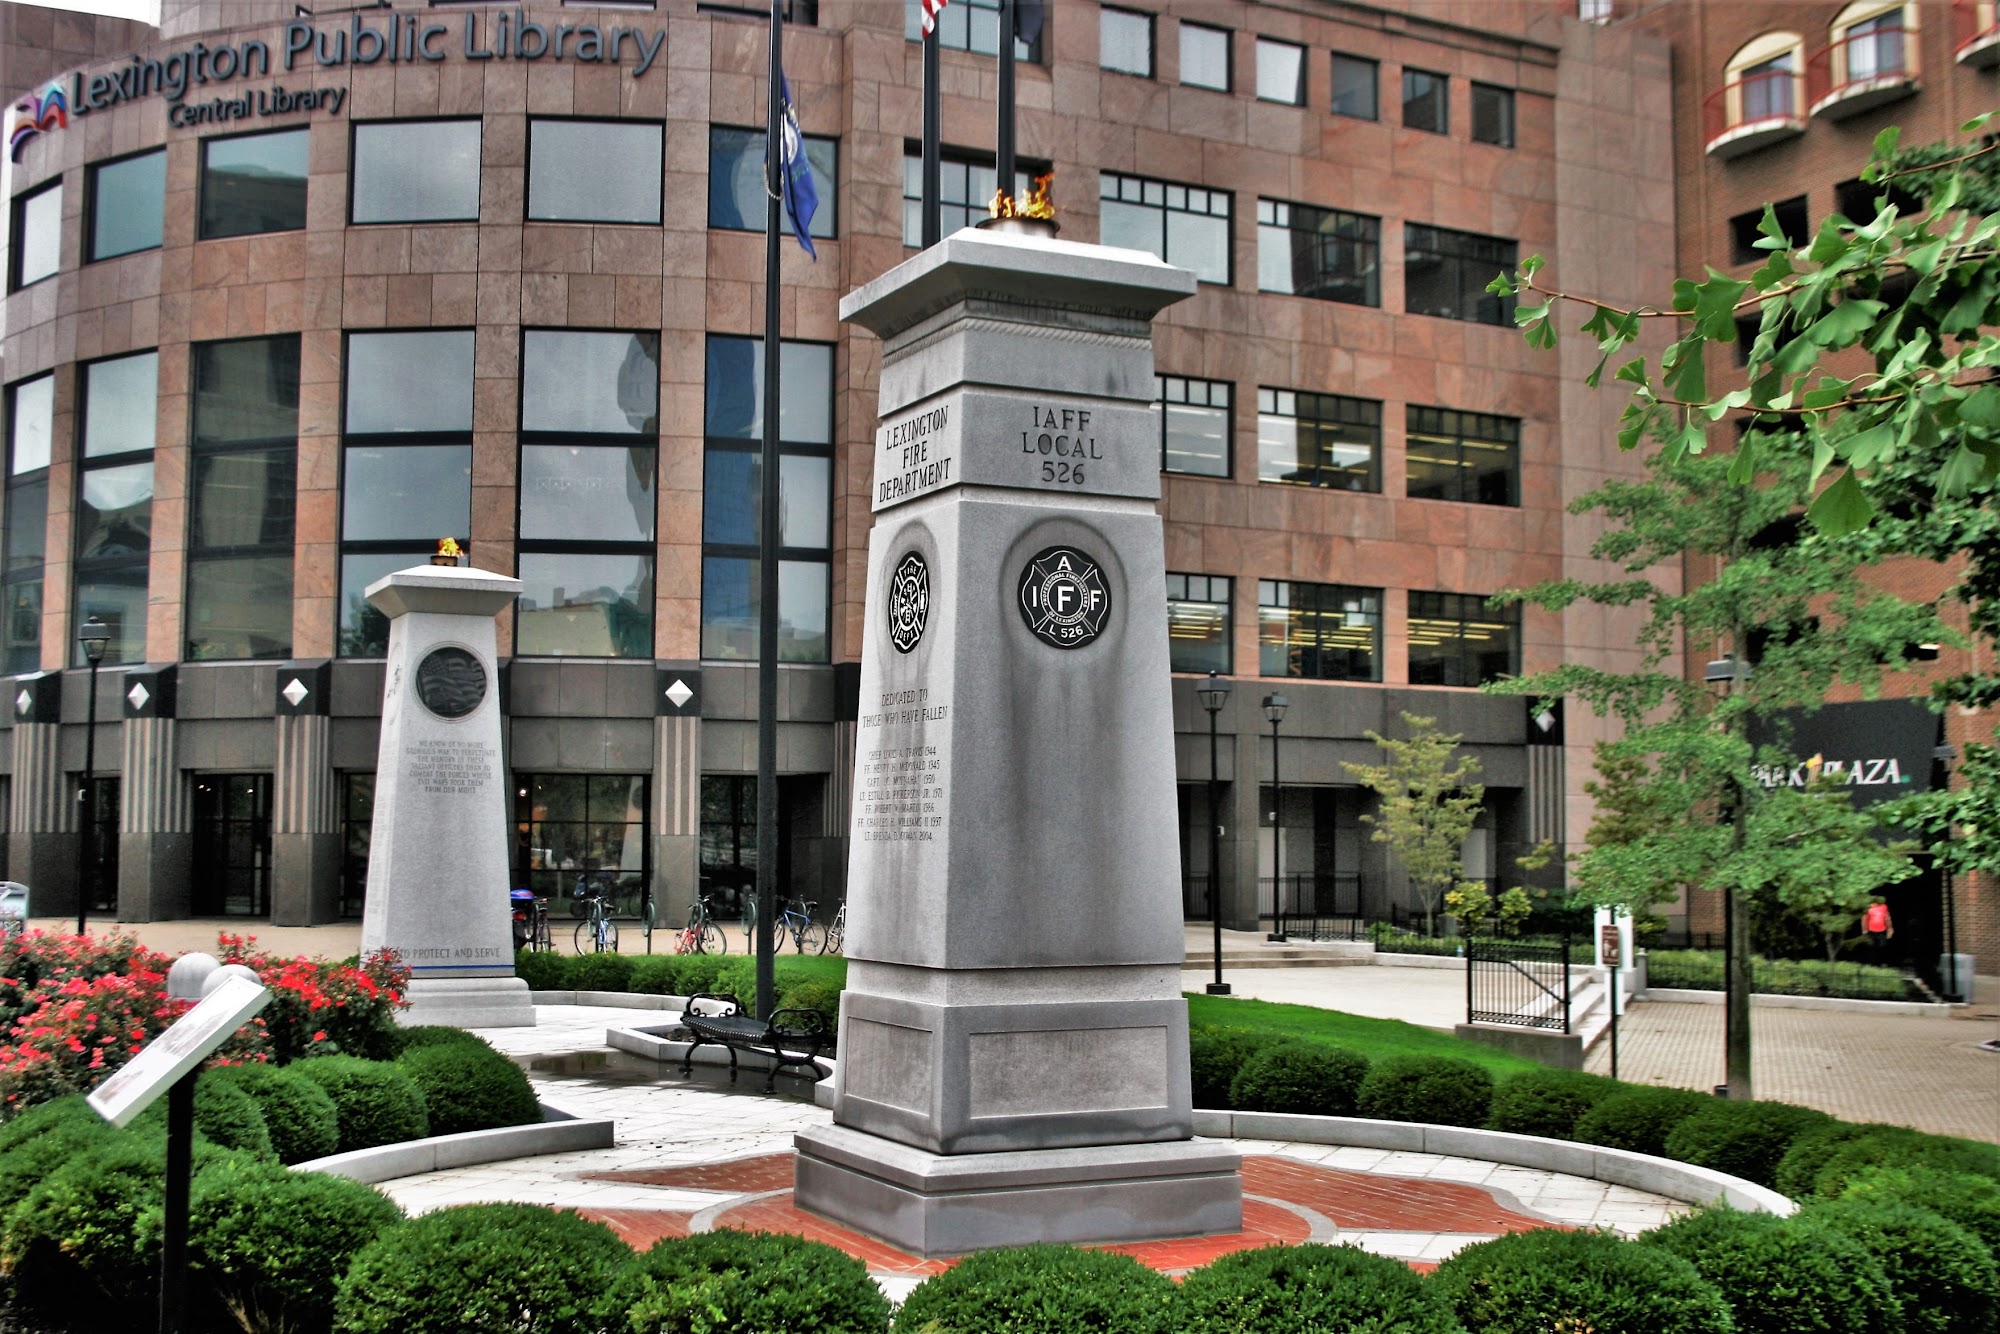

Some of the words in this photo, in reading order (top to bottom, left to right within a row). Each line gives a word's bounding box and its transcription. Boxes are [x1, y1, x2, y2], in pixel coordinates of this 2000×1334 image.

[71, 39, 268, 116] Lexington
[283, 13, 447, 69] Public
[463, 6, 667, 76] Library
[167, 92, 250, 128] Central
[257, 86, 345, 114] Library
[886, 405, 949, 450] LEXINGTON
[1033, 406, 1091, 432] IAFF
[903, 440, 928, 469] FIRE
[1022, 431, 1103, 460] LOCAL
[879, 457, 951, 503] DEPARTMENT
[1041, 461, 1085, 485] 526
[1057, 555, 1072, 571] A
[1042, 571, 1066, 606] PROFESSIONAL
[1065, 572, 1088, 608] FIREFIGHTERS
[1057, 585, 1074, 612] F
[1090, 589, 1102, 611] F
[1055, 611, 1084, 624] LEXINGTON
[1049, 624, 1056, 636] L
[1060, 625, 1084, 638] 526
[881, 689, 916, 707] DEDICATED
[919, 688, 928, 703] TO
[862, 713, 882, 729] THOSE
[884, 711, 899, 726] WHO
[901, 708, 919, 724] HAVE
[921, 705, 949, 722] FALLEN
[413, 948, 450, 959] PROTECT
[454, 948, 473, 958] AND
[475, 947, 500, 958] SERVE
